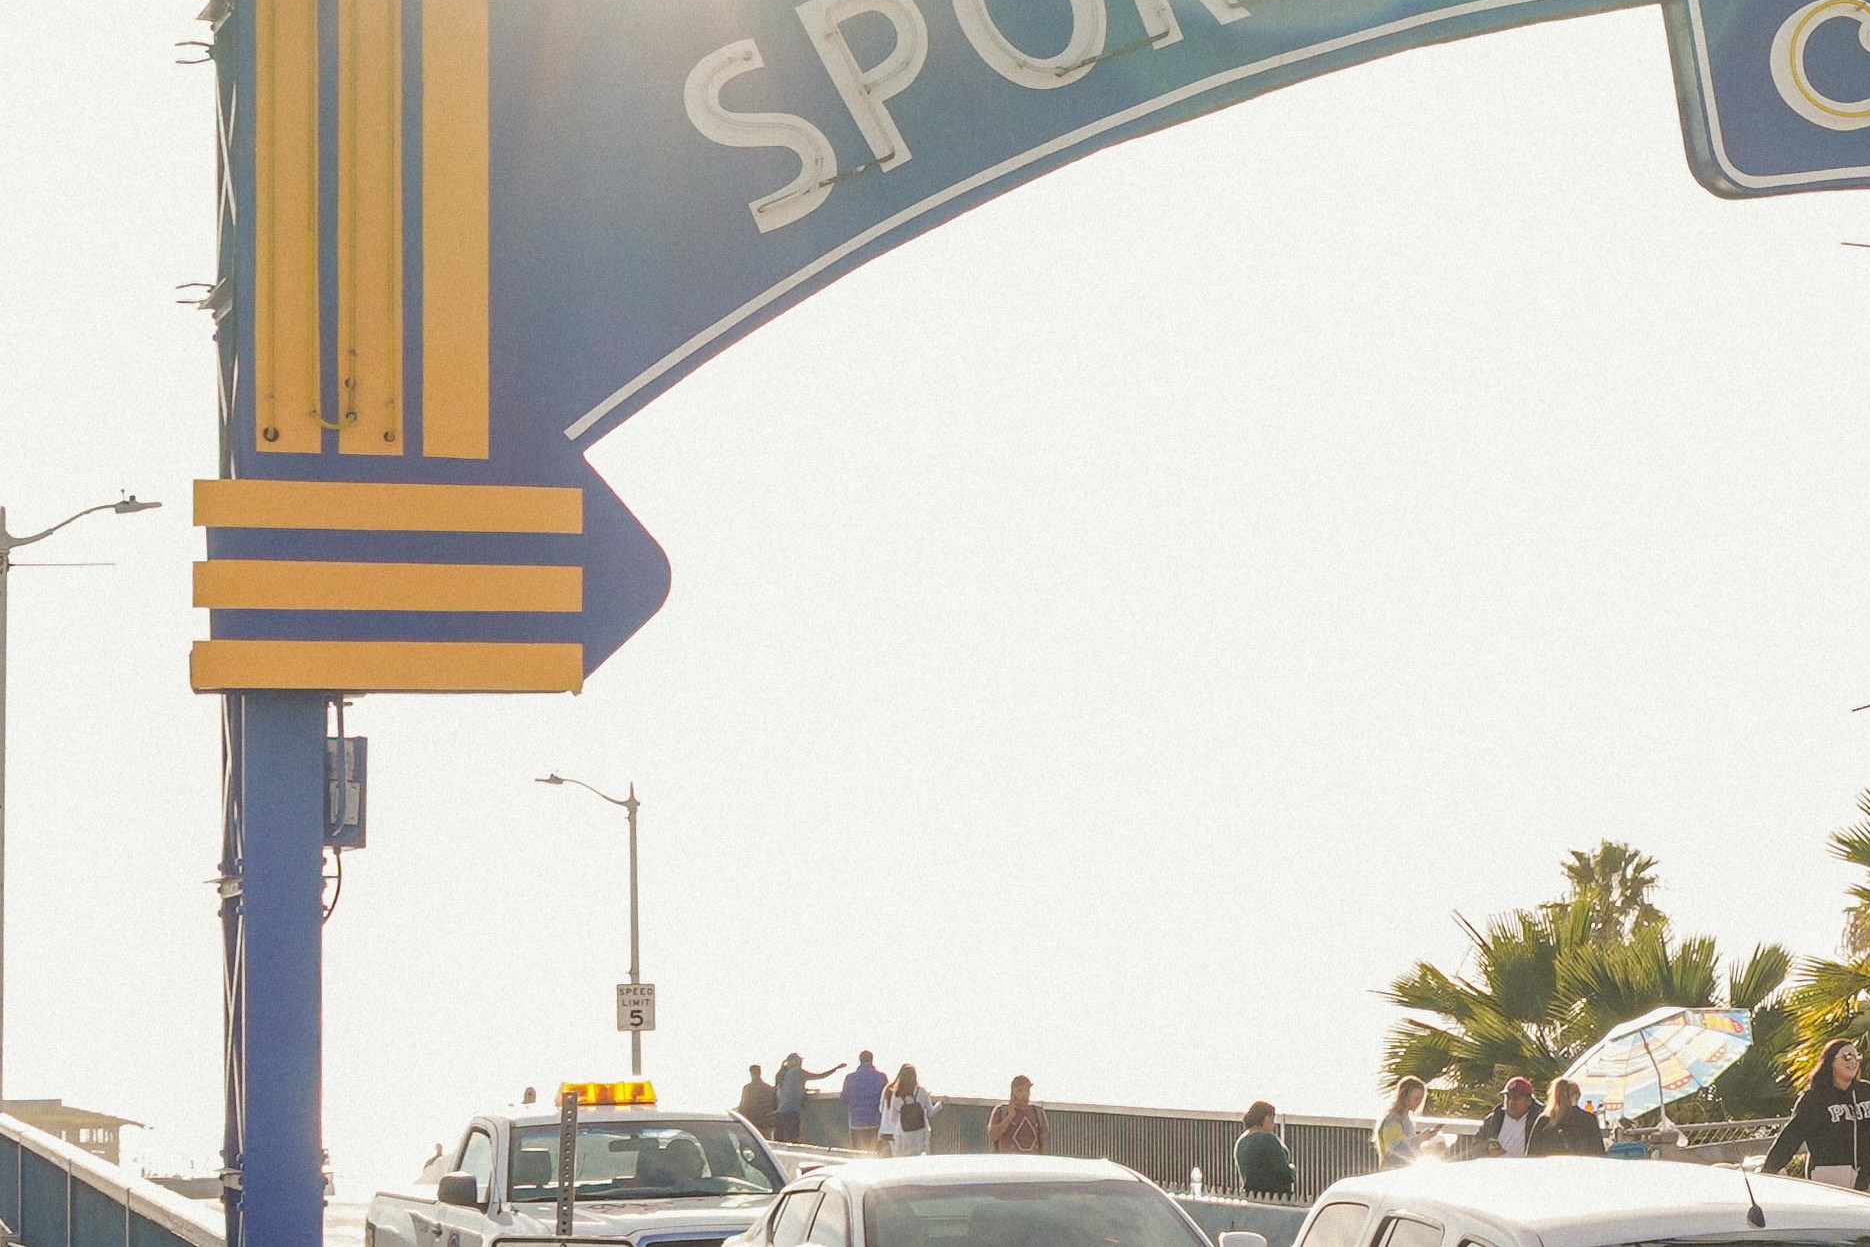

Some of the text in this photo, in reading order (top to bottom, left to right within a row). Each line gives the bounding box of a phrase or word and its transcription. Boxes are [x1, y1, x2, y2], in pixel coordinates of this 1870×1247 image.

[619, 987, 653, 996] SPEED
[621, 998, 651, 1007] LIMIT
[630, 1009, 644, 1026] 5
